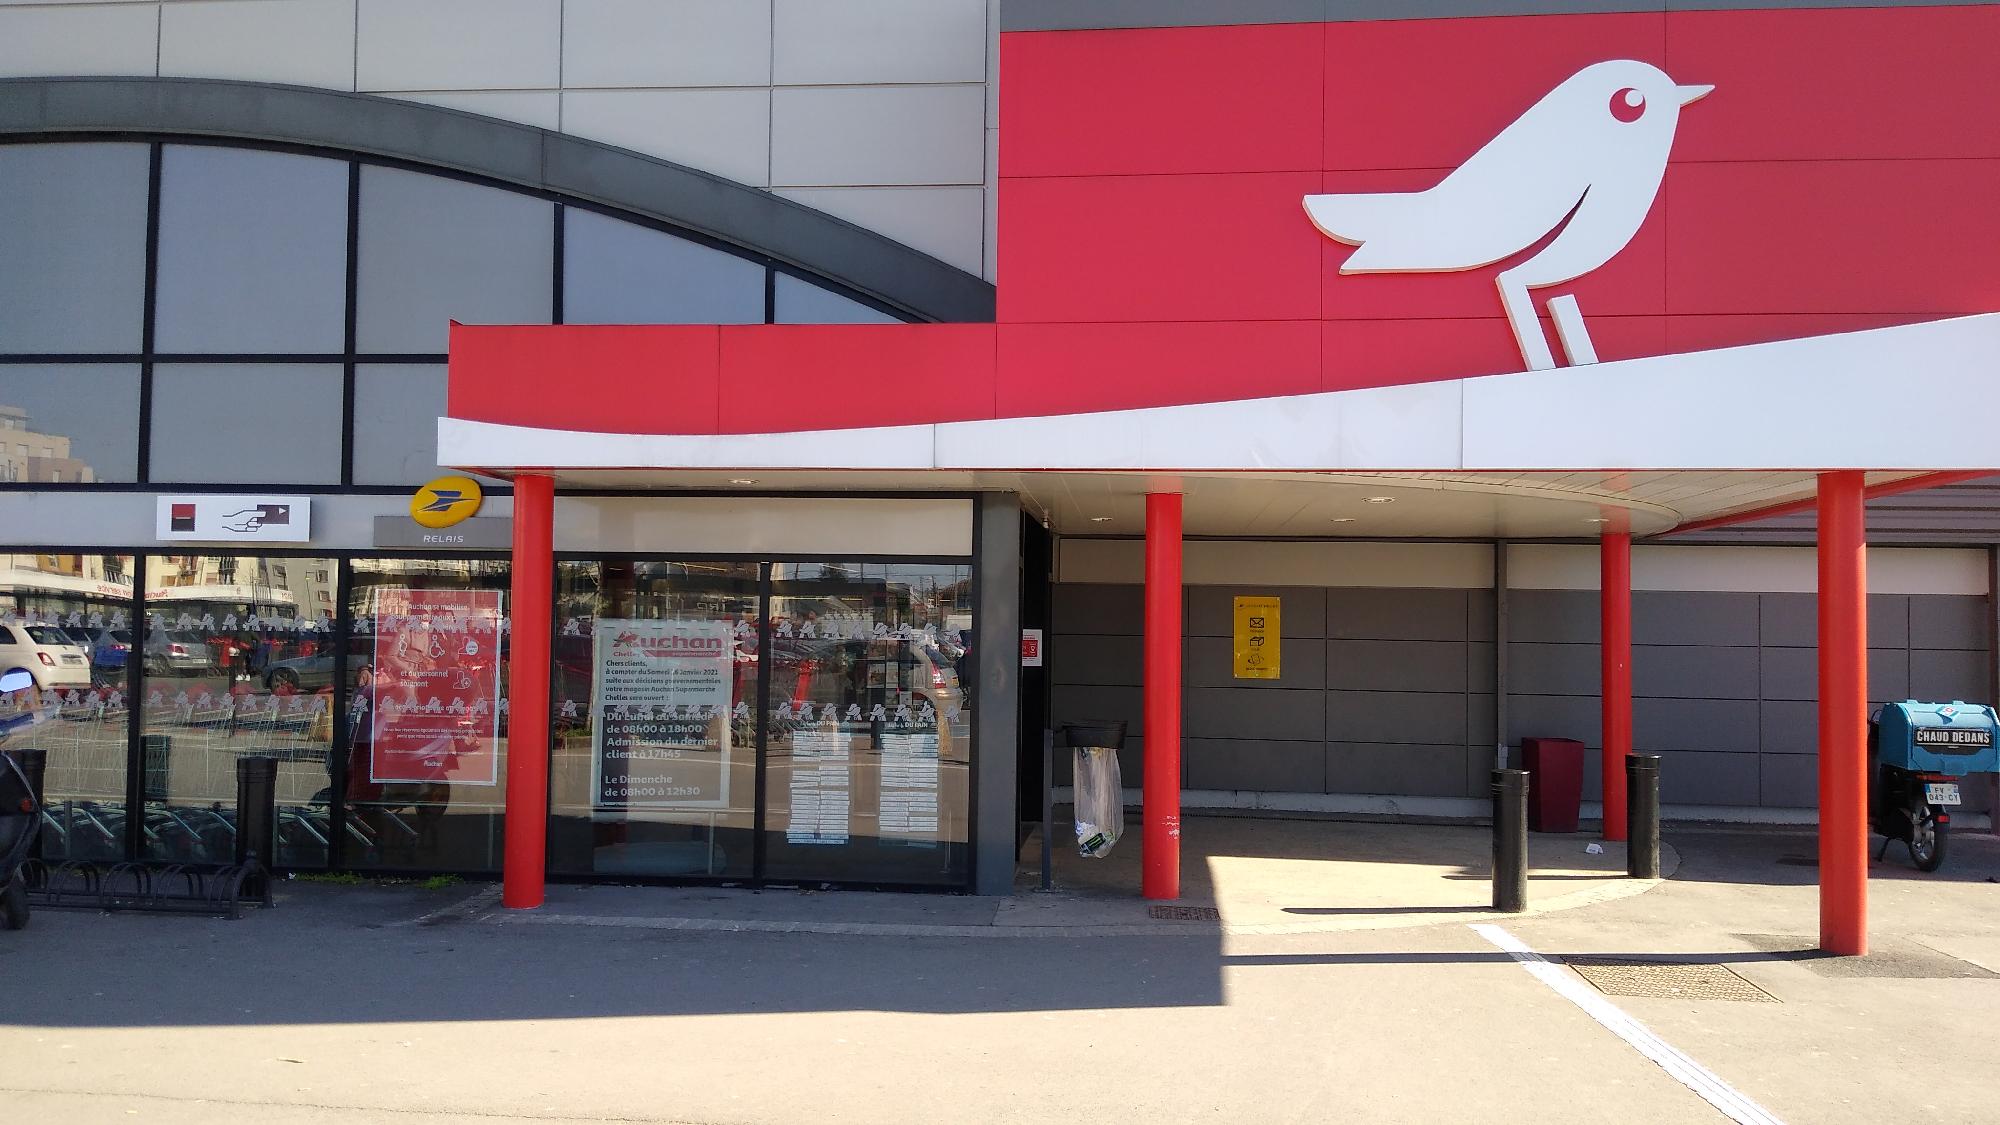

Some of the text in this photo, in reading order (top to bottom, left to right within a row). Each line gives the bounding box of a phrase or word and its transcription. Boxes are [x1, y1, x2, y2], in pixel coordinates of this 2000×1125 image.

[423, 534, 464, 543] RELAIS
[613, 631, 721, 649] Auchan
[417, 669, 449, 678] personnel
[611, 669, 637, 677] compter
[623, 686, 649, 694] magasin
[606, 724, 703, 733] de 08h00 à 18h00
[606, 735, 719, 746] Admission du dernier
[1916, 731, 1990, 743] CHAUD DEDANS
[606, 749, 681, 759] client à 17h45
[605, 774, 673, 784] Le Dimanche
[604, 786, 701, 797] de 08h00 à 12h30
